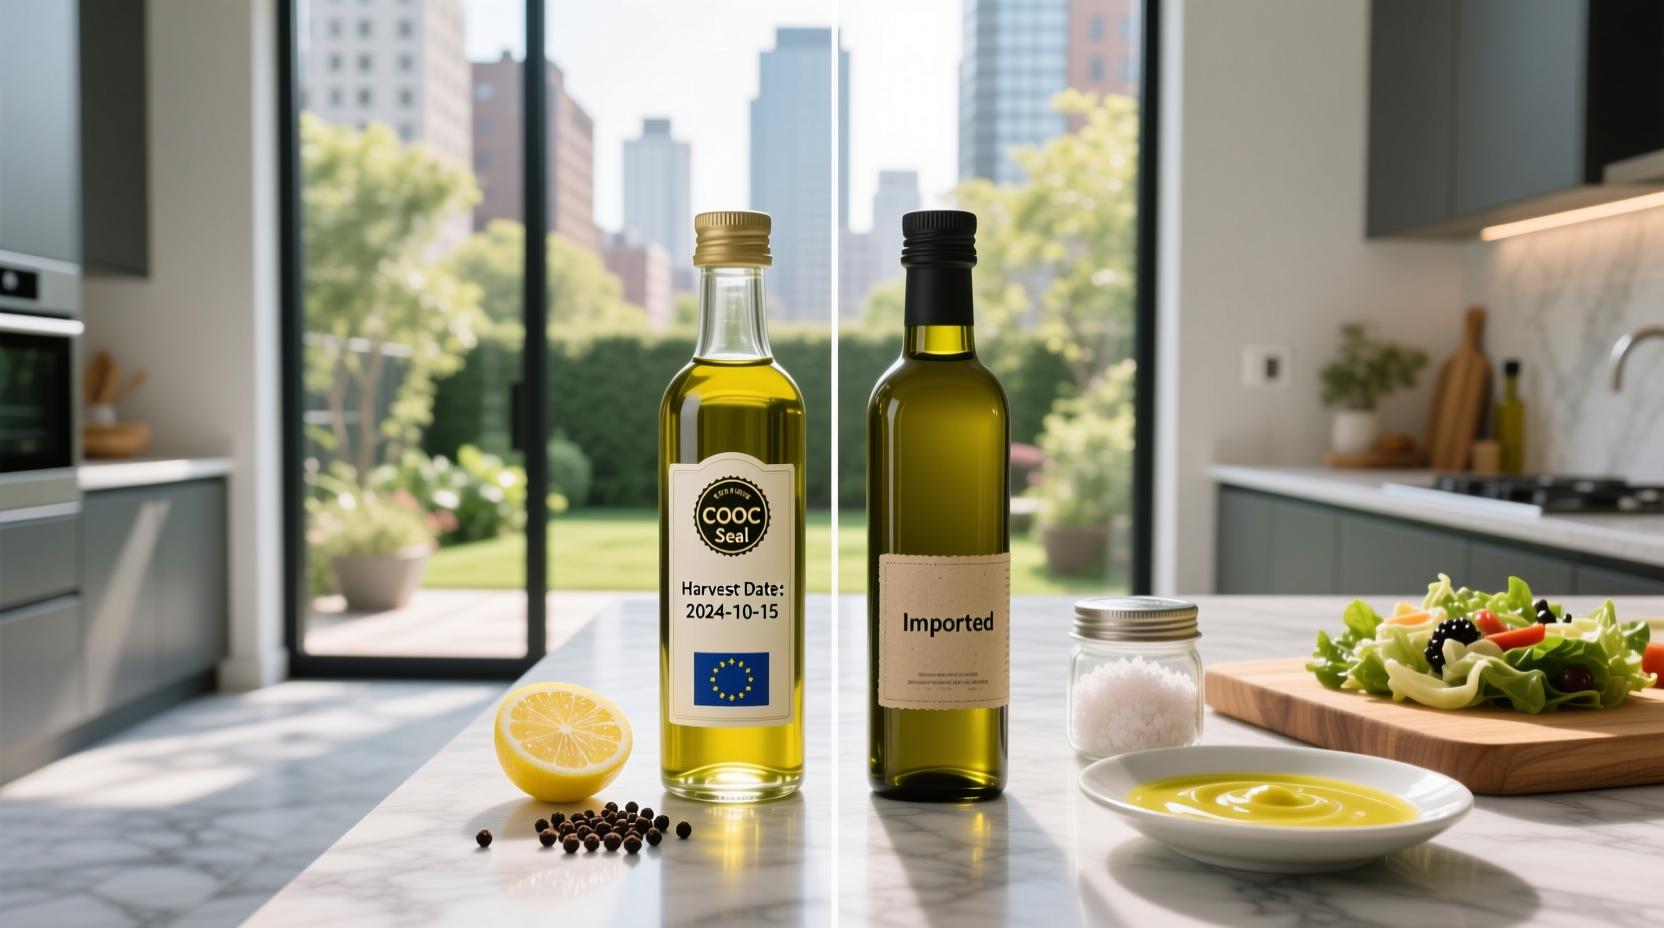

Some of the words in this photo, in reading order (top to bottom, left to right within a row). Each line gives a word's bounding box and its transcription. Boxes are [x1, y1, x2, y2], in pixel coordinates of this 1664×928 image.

[703, 506, 761, 525] COOC
[715, 527, 749, 543] Seal
[682, 580, 740, 596] Harvest
[744, 581, 784, 597] Date:
[686, 603, 778, 620] 2024-10-15
[903, 611, 994, 637] Imported
